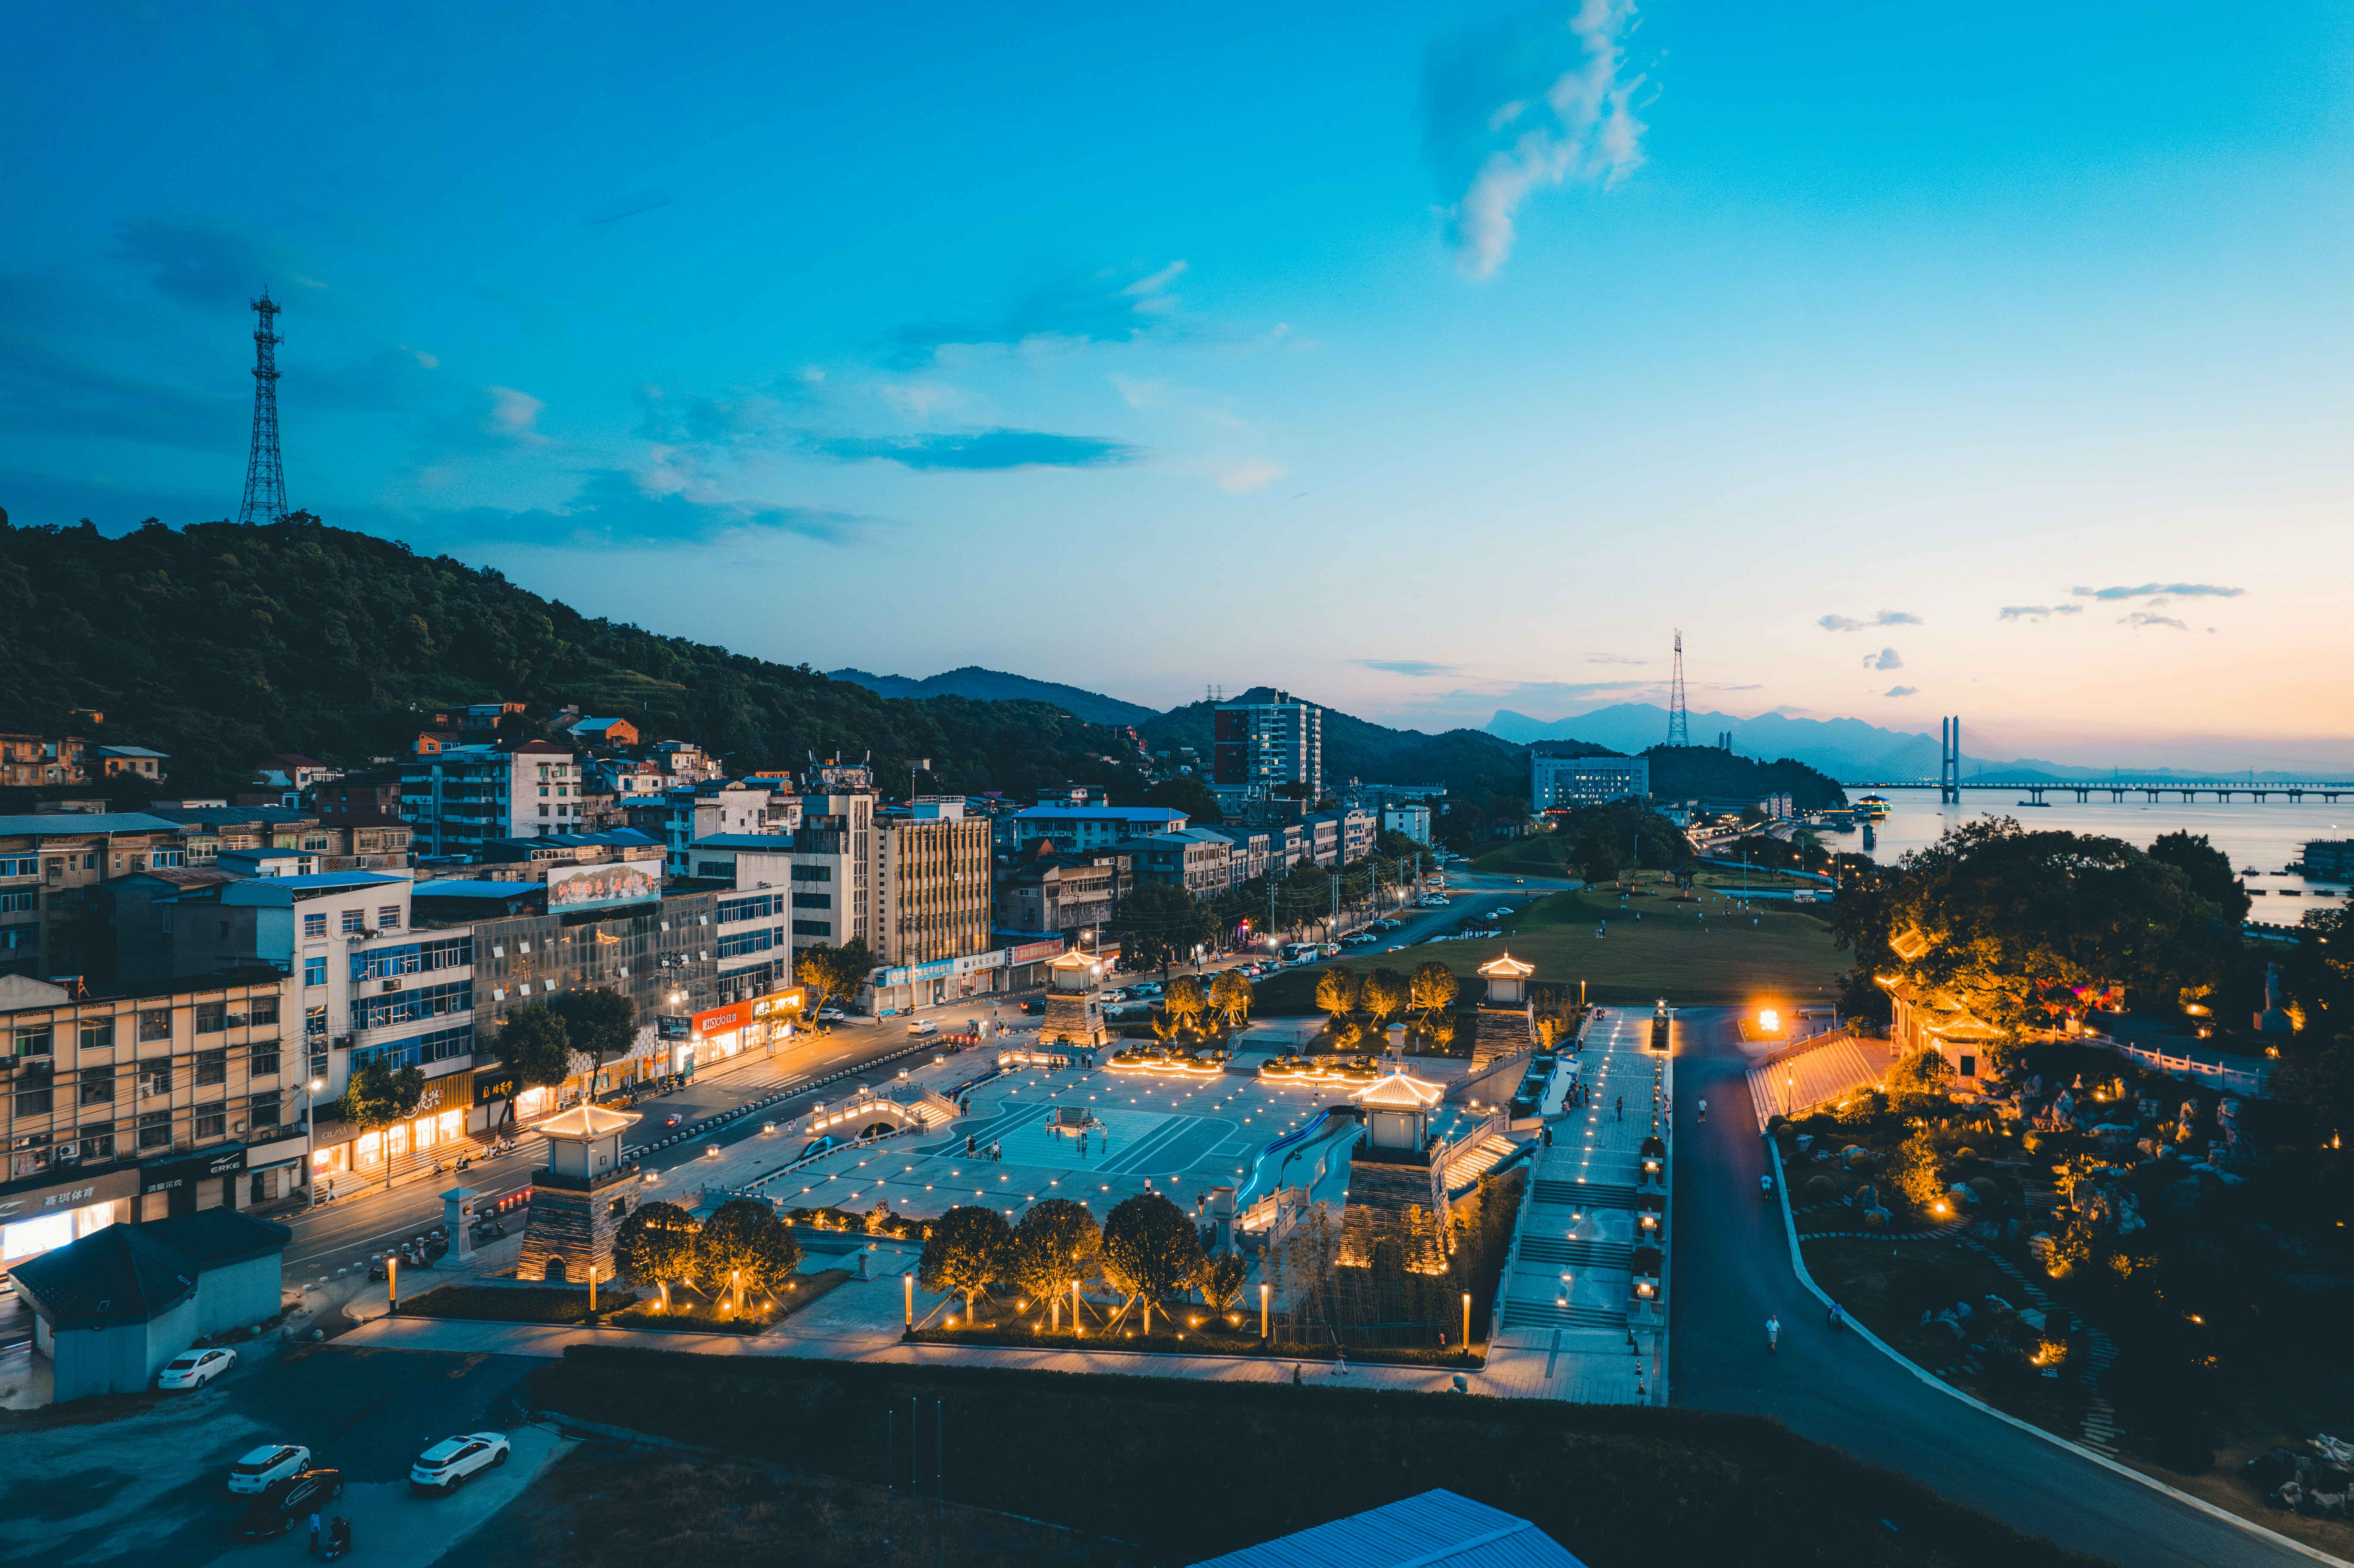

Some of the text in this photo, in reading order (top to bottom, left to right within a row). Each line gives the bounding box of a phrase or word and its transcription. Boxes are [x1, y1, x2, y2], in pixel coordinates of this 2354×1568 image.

[211, 1162, 240, 1173] ERKE
[148, 1179, 183, 1193] 鸿星尔克
[44, 1187, 95, 1207] 赛琪体育
